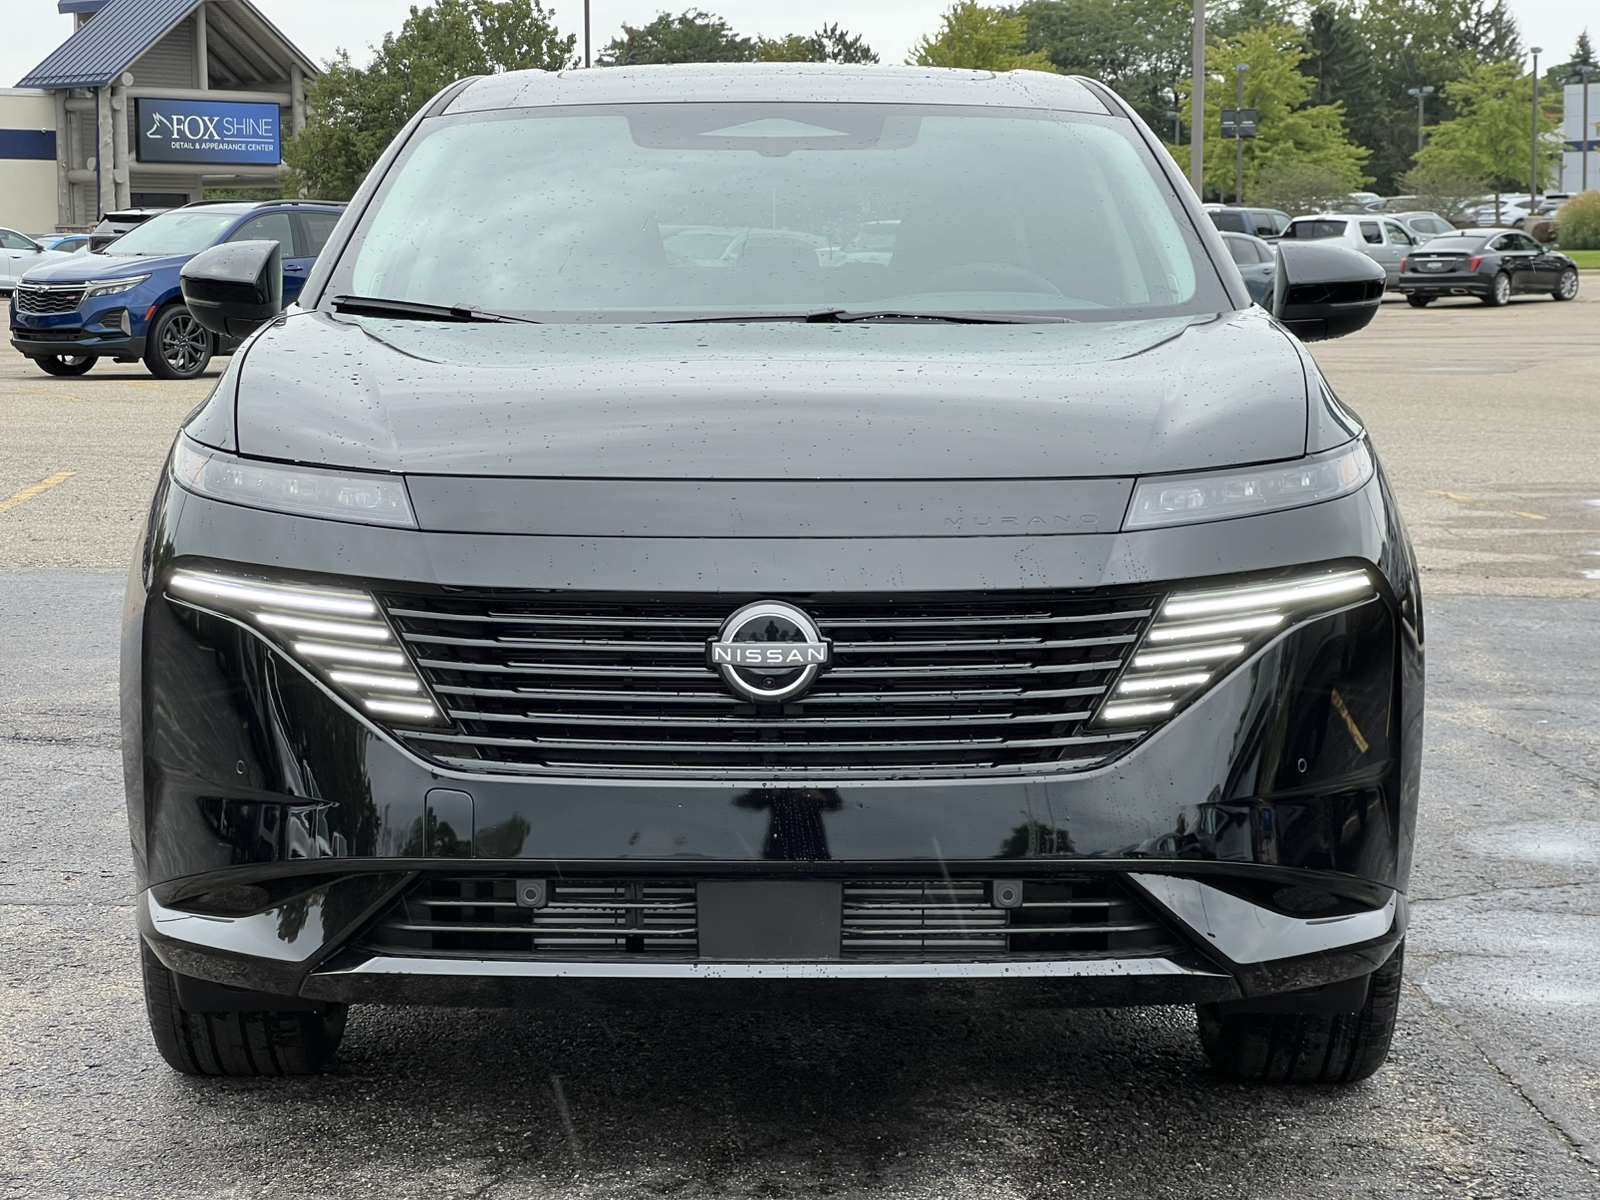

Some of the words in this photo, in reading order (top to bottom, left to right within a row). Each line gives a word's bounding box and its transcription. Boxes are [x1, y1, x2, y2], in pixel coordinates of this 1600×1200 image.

[171, 115, 221, 140] FOX
[223, 117, 273, 136] SHINE
[171, 141, 194, 149] DETAIL
[201, 142, 246, 151] APPEARANCE
[247, 143, 274, 151] CENTER
[944, 514, 1099, 527] MURANO
[715, 647, 825, 663] NISSAN
